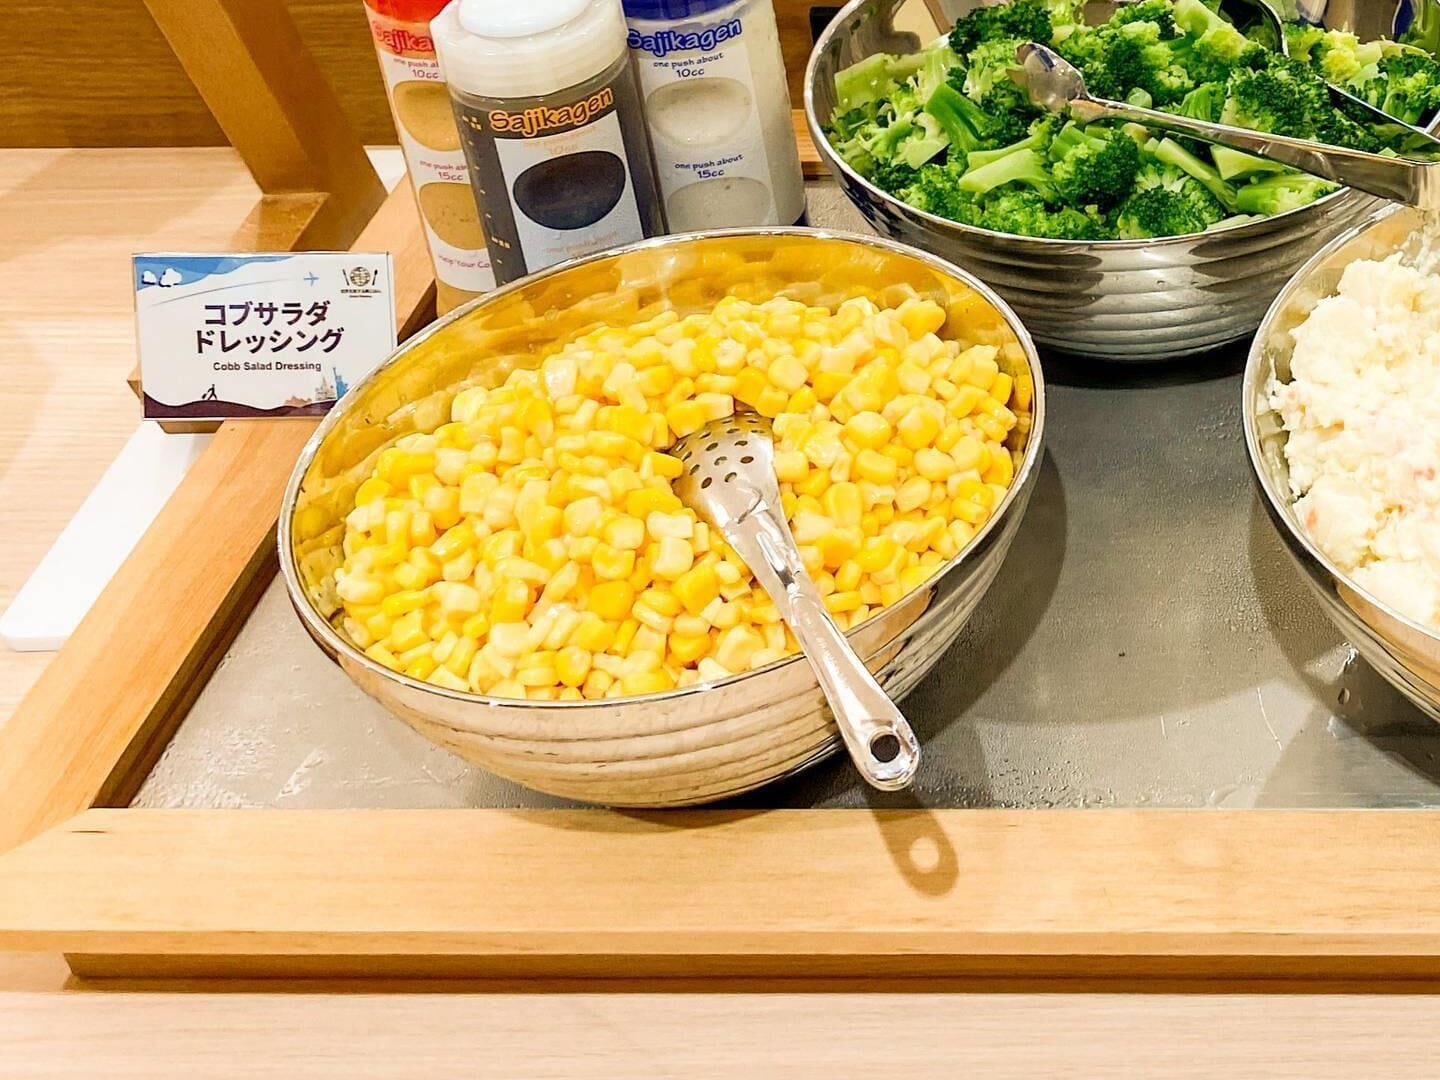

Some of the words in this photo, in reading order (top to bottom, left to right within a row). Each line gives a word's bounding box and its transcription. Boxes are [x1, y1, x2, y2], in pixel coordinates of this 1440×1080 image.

[627, 18, 742, 58] Sajikagen
[671, 59, 695, 70] push
[696, 52, 724, 65] about
[412, 69, 439, 79] 10cc
[676, 67, 705, 78] 10cc
[489, 87, 614, 137] Sajikagen
[692, 160, 715, 171] push
[716, 153, 744, 166] about
[438, 171, 464, 181] 15cc
[697, 169, 725, 179] 15cc
[204, 300, 331, 326] コブサラダ
[196, 327, 345, 354] ドレッシング
[213, 361, 241, 371] Cobb
[243, 361, 273, 371] Salad
[275, 361, 322, 372] Dressing
